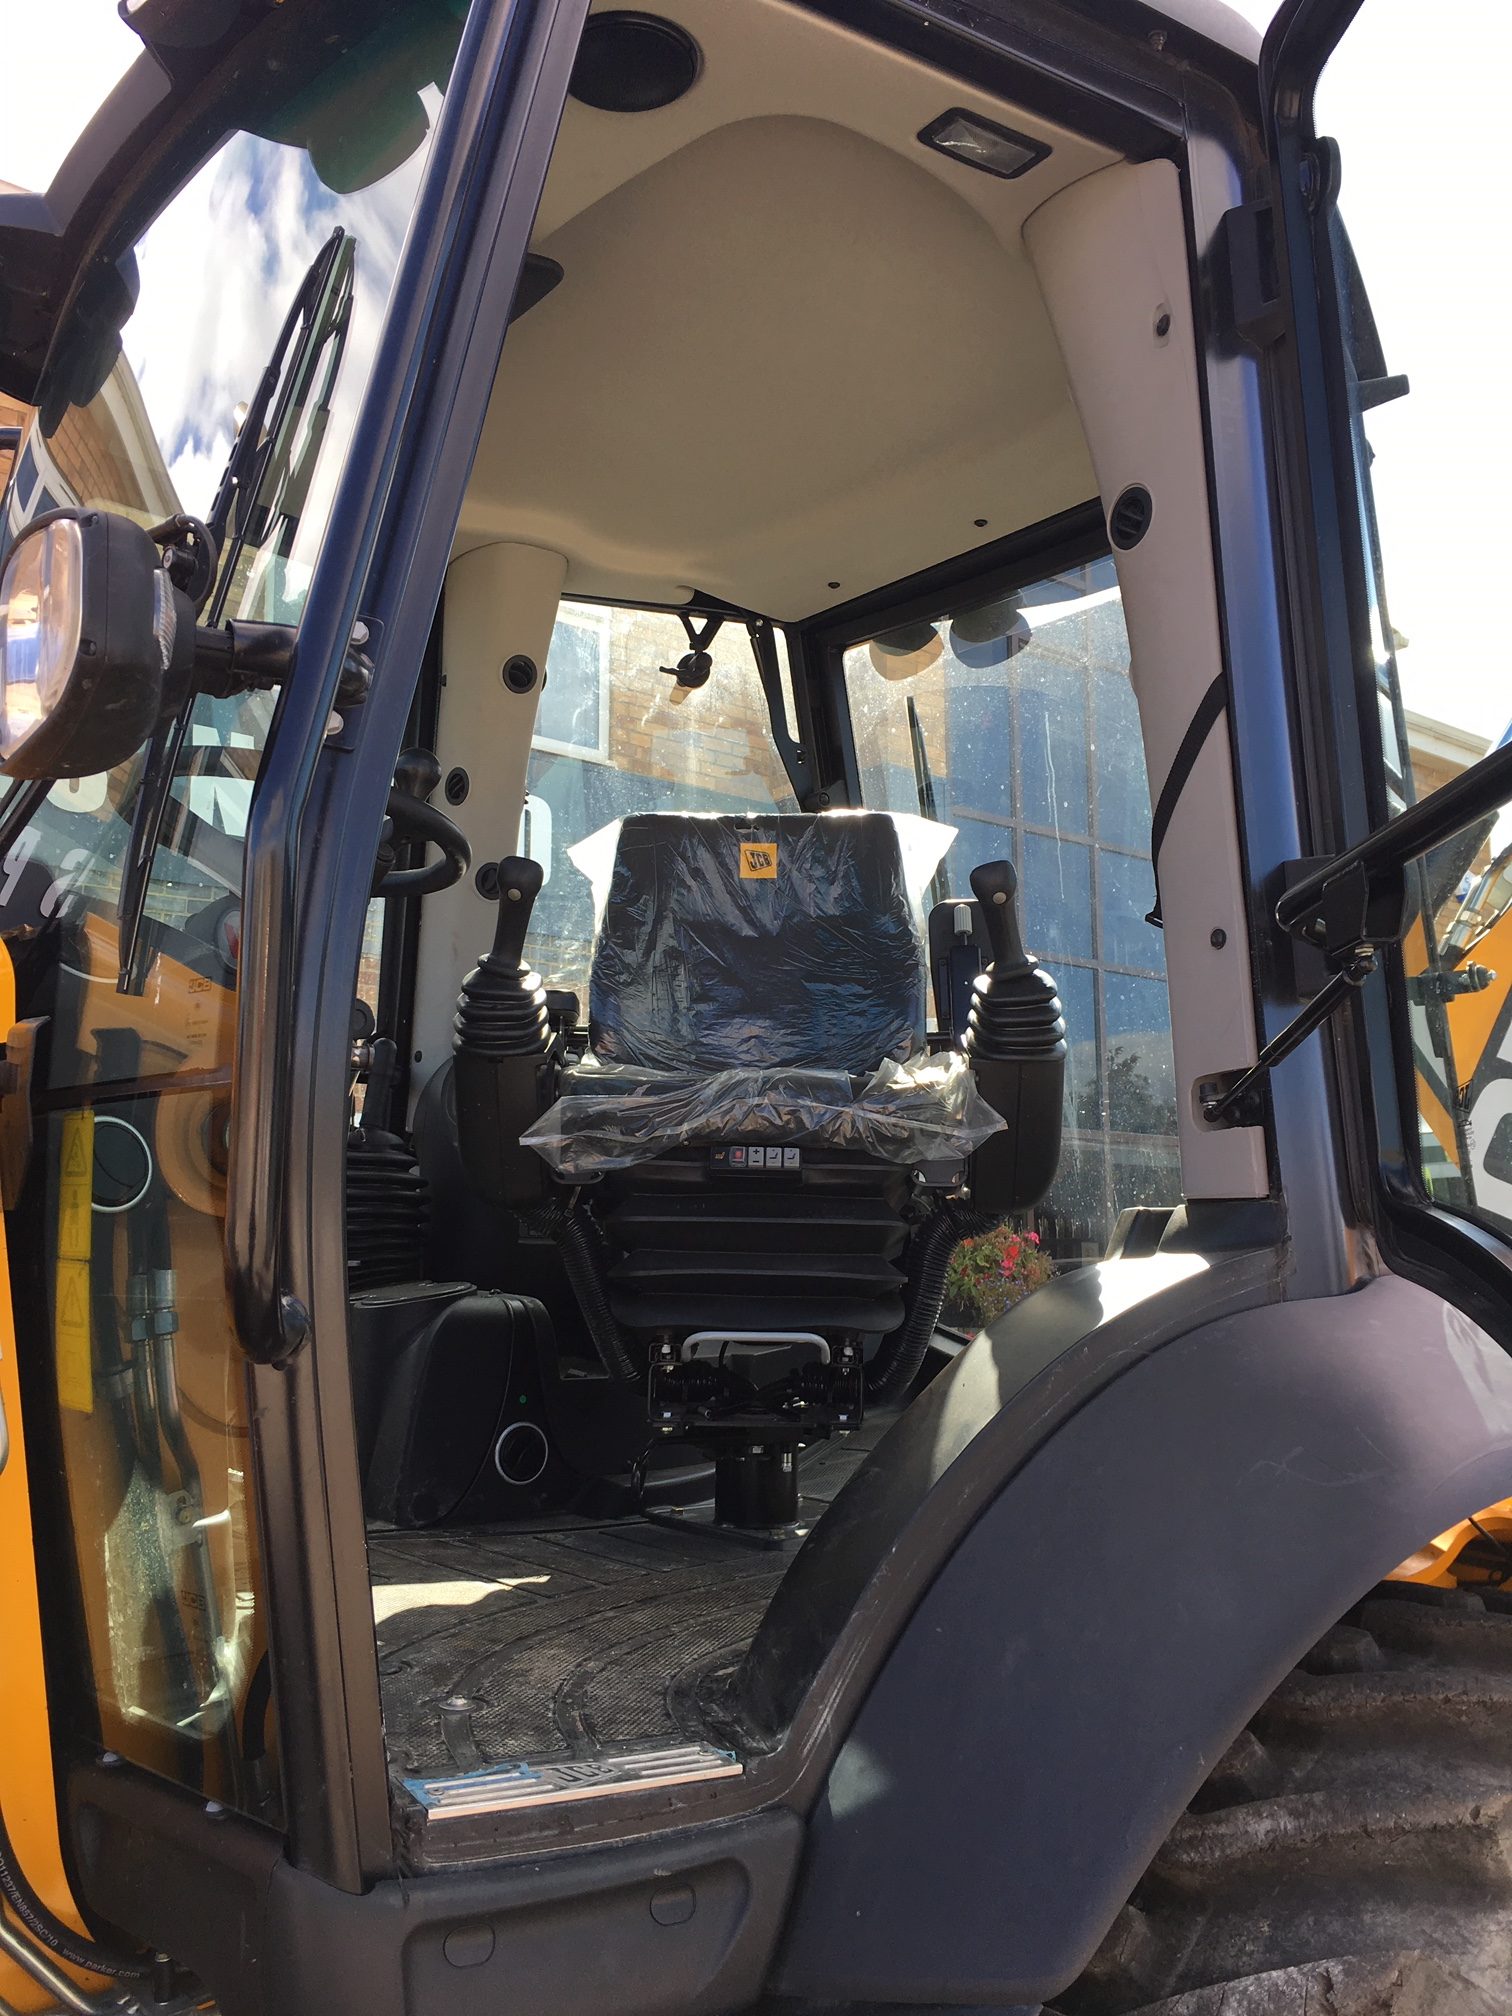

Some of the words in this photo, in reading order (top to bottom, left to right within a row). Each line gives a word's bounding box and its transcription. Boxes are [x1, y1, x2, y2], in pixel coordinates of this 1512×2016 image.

[750, 852, 770, 869] JCB
[545, 1764, 615, 1782] JCB
[62, 1947, 140, 1978] www.parker.com
